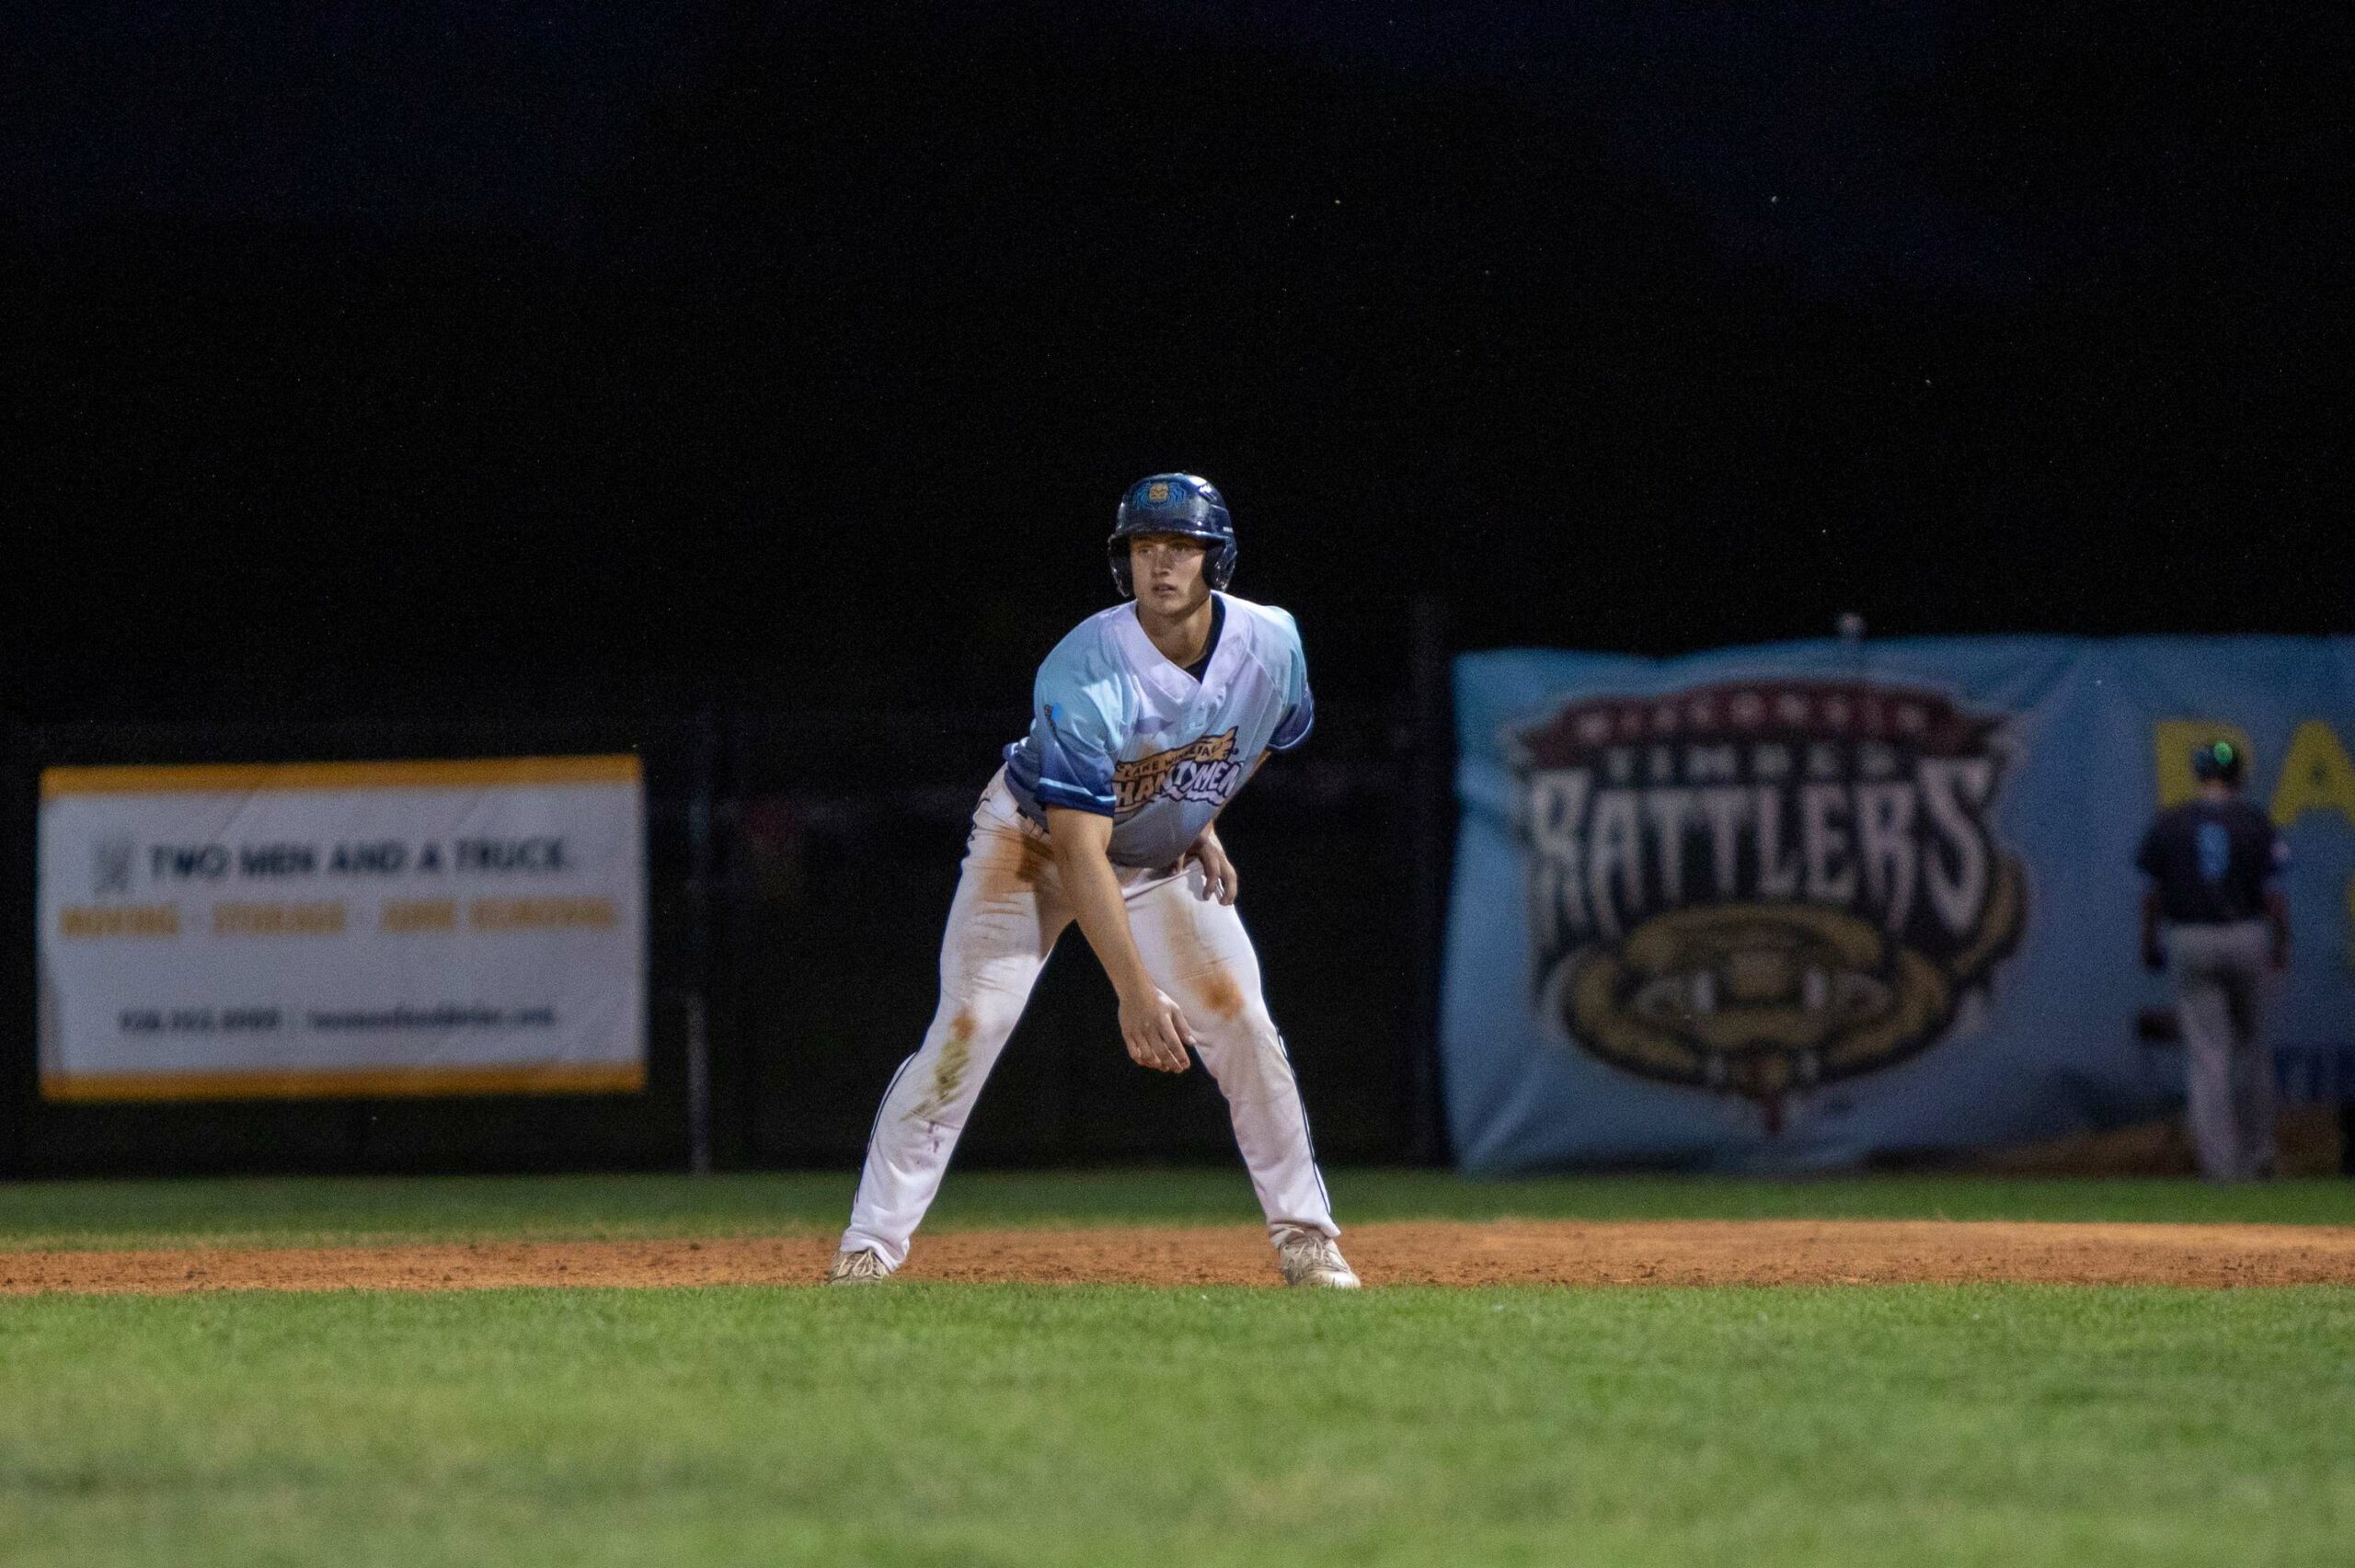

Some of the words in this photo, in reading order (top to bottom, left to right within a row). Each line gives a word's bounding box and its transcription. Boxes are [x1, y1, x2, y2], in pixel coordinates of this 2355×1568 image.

[1111, 760, 1243, 807] HANTYMEN
[1124, 761, 1160, 777] LAKE
[148, 842, 228, 878] TWO
[240, 841, 316, 876] MEN
[330, 839, 405, 875] AND
[418, 838, 443, 873] A
[458, 836, 566, 874] TRUCK
[1528, 755, 1994, 953] RATTLERS
